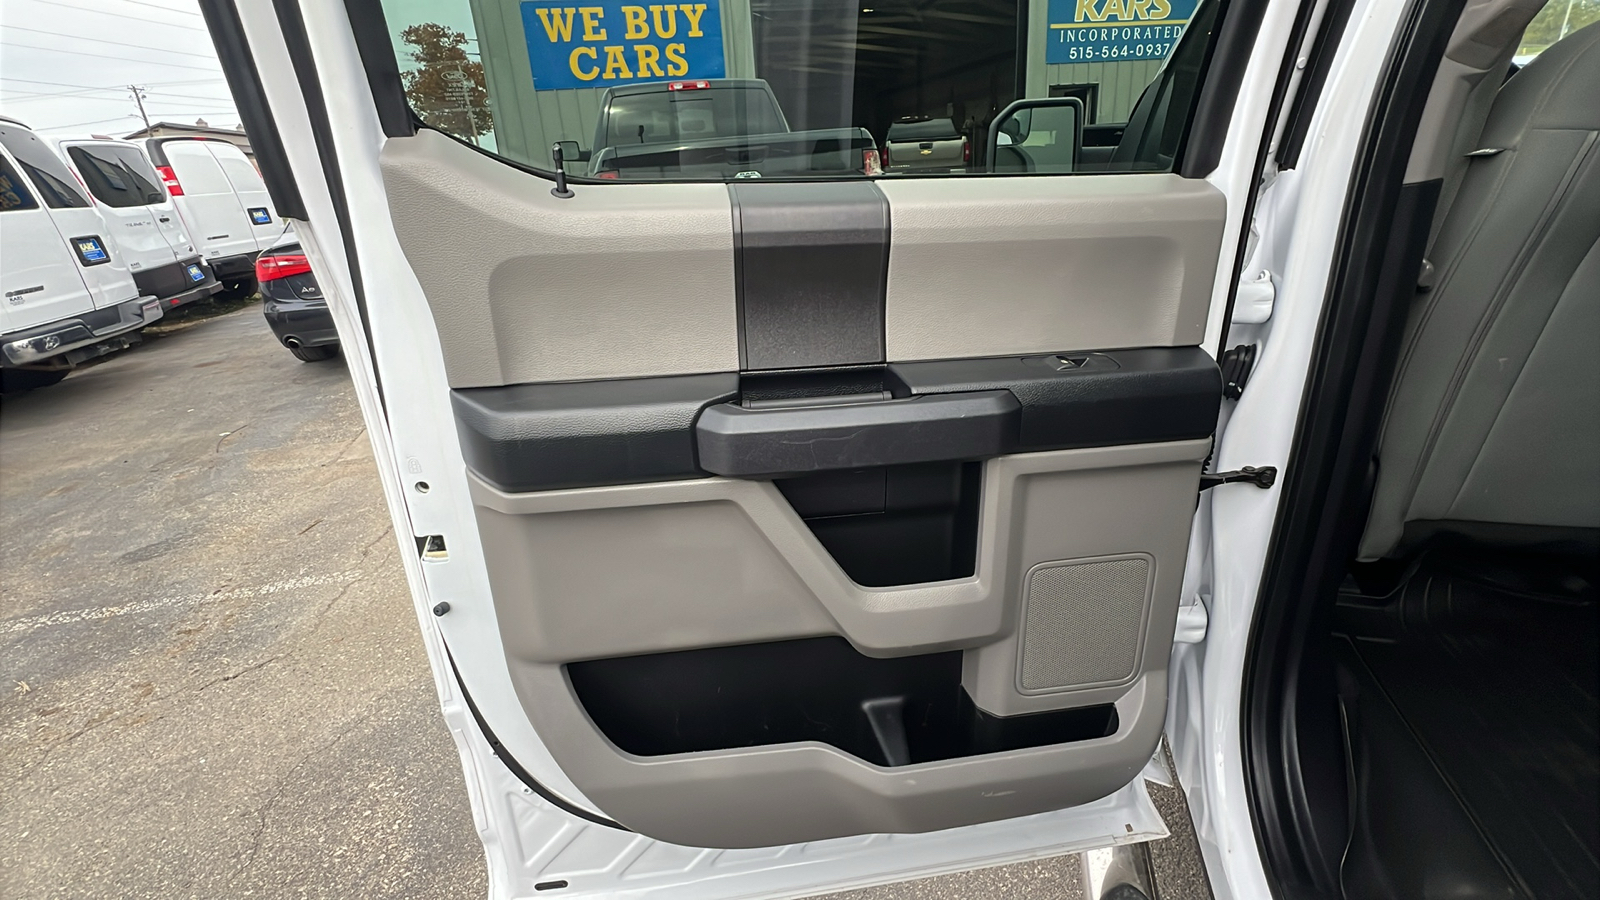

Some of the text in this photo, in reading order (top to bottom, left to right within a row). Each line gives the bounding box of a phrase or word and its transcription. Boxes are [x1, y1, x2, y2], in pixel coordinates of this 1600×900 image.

[1074, 0, 1171, 22] KARS
[535, 3, 707, 43] WE BUY
[1060, 26, 1182, 43] INCORPORATED
[569, 43, 689, 81] CARS
[1069, 43, 1170, 60] 515-564-0937
